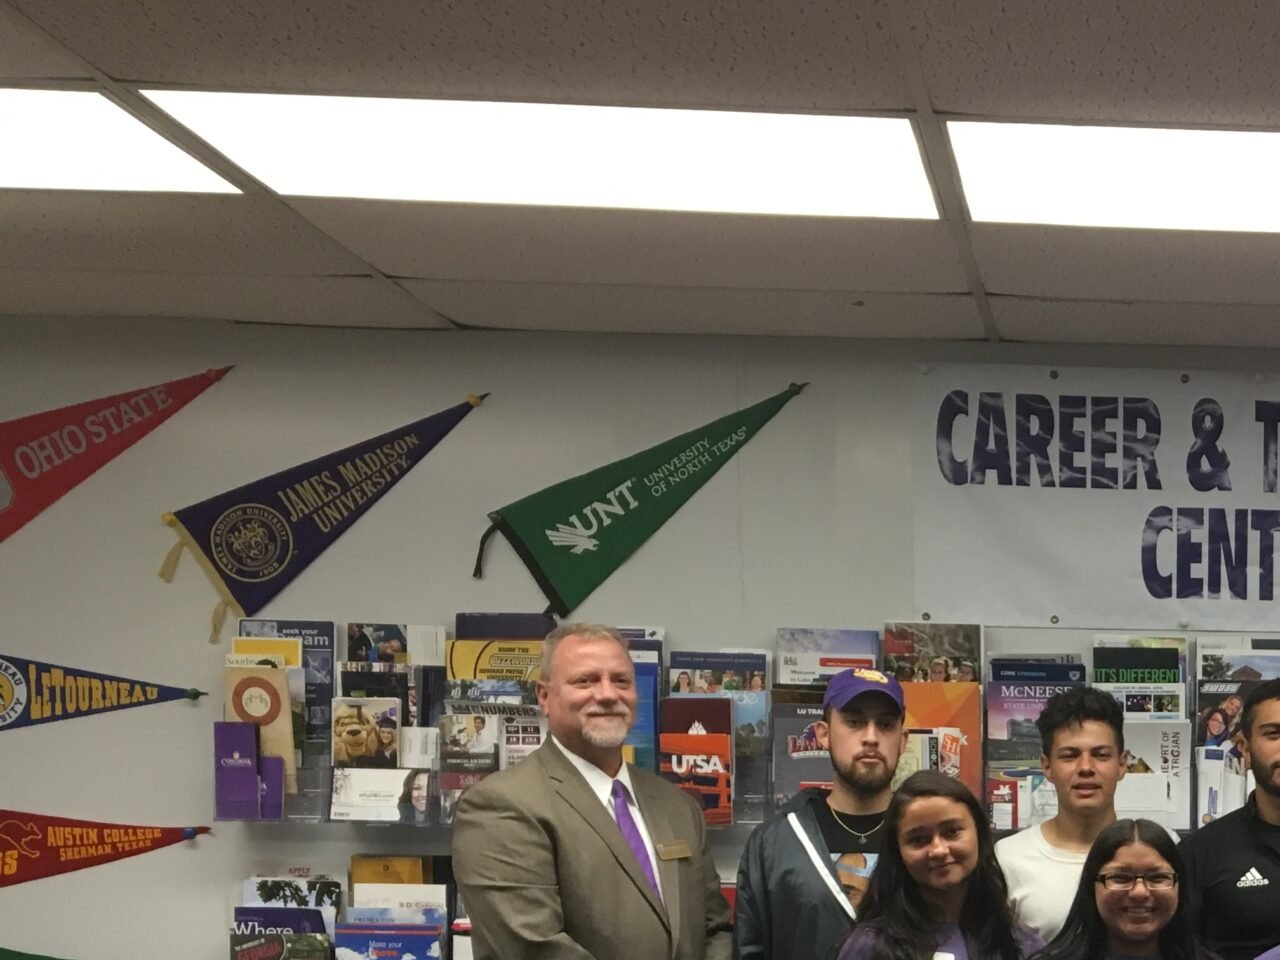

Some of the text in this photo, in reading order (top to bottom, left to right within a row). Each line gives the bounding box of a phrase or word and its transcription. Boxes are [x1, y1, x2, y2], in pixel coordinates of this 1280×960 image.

[15, 385, 172, 480] OHIO STATE
[936, 389, 1163, 491] CAREER
[1186, 398, 1233, 493] &
[643, 438, 711, 488] UNIVERSITY
[651, 480, 668, 498] OF
[666, 451, 713, 488] NORTH
[277, 433, 420, 523] JAMES MADISON
[310, 455, 411, 534] UNIVERSITY
[568, 479, 640, 539] UNT
[1119, 669, 1179, 683] DIFFERENT
[480, 704, 537, 717] NUMBERS
[1003, 702, 1025, 710] STATE
[671, 754, 727, 774] UTSA
[47, 825, 162, 848] AUSTIN COLLEGE
[117, 840, 153, 852] TEXAS
[1236, 877, 1270, 888] adidas
[233, 921, 294, 935] Where
